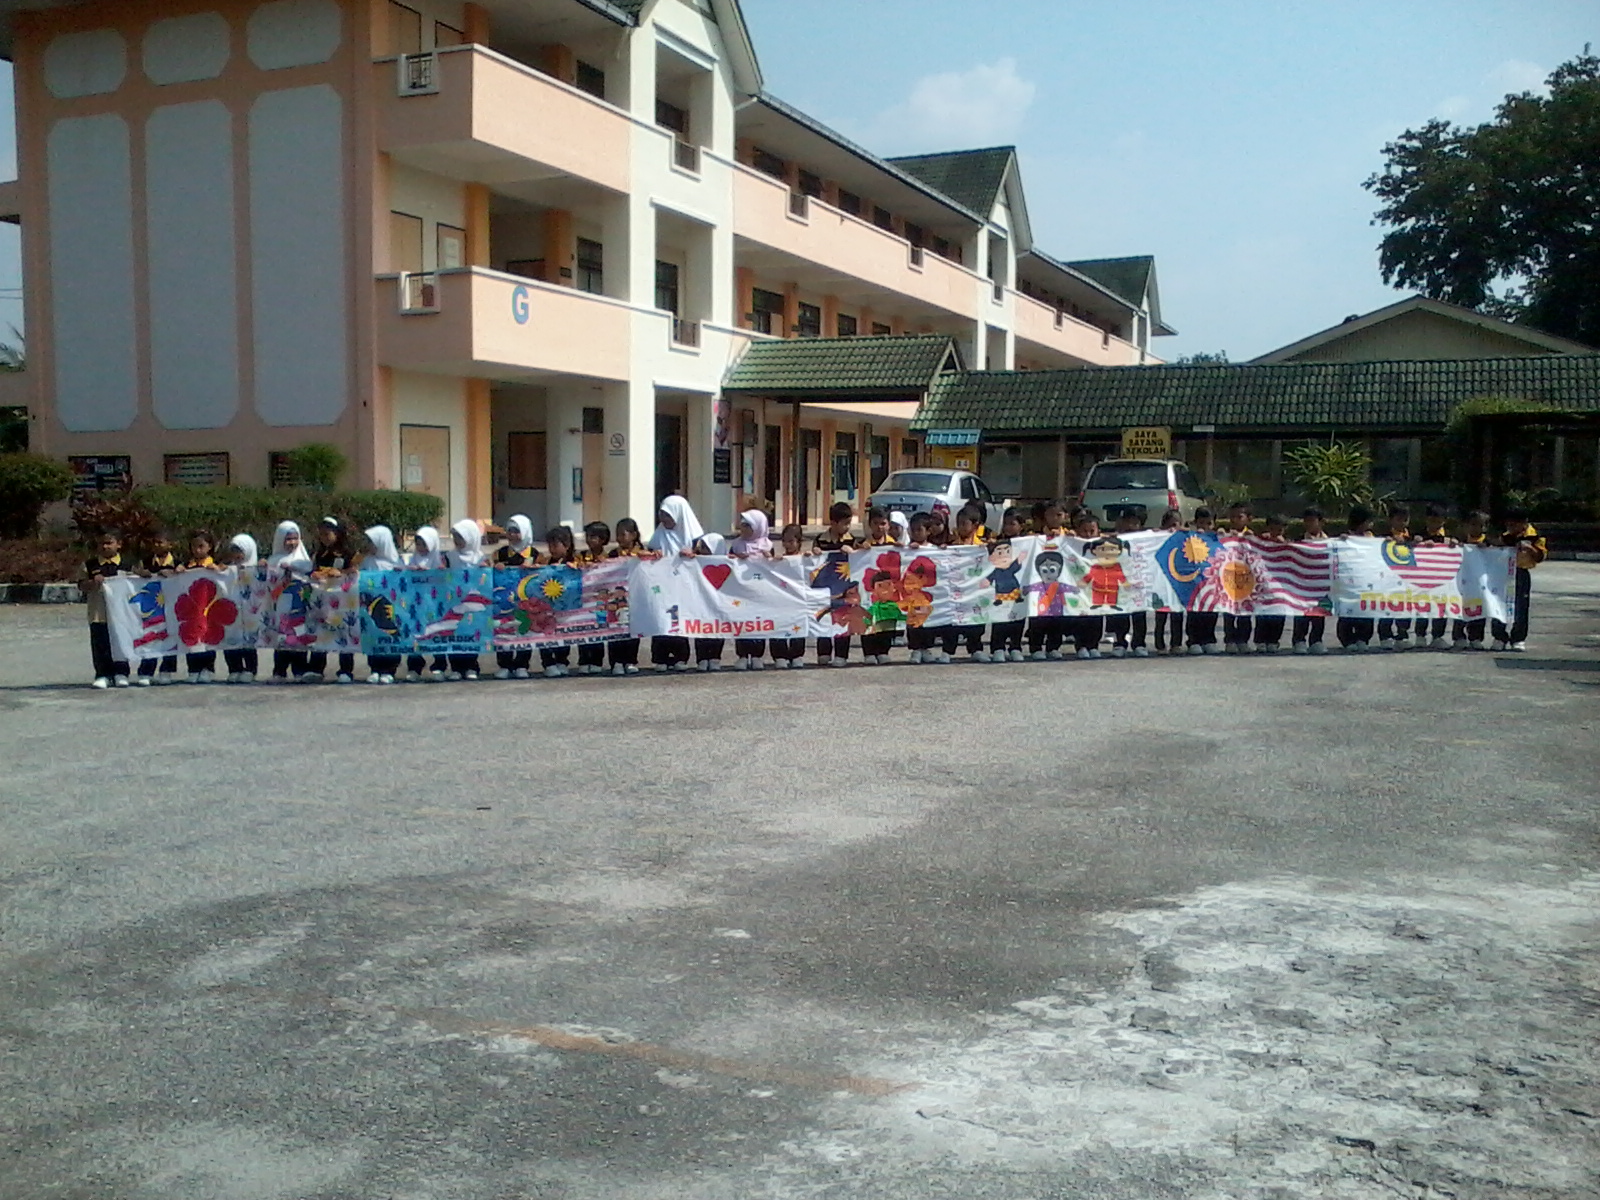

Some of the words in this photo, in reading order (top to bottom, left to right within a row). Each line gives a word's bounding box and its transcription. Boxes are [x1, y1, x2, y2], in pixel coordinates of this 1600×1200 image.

[512, 284, 529, 325] G
[1134, 430, 1157, 438] SAYA
[1126, 447, 1166, 455] SEKOLAH
[1360, 588, 1483, 618] malaysa
[666, 604, 680, 634] 1
[685, 616, 775, 637] Malaysia
